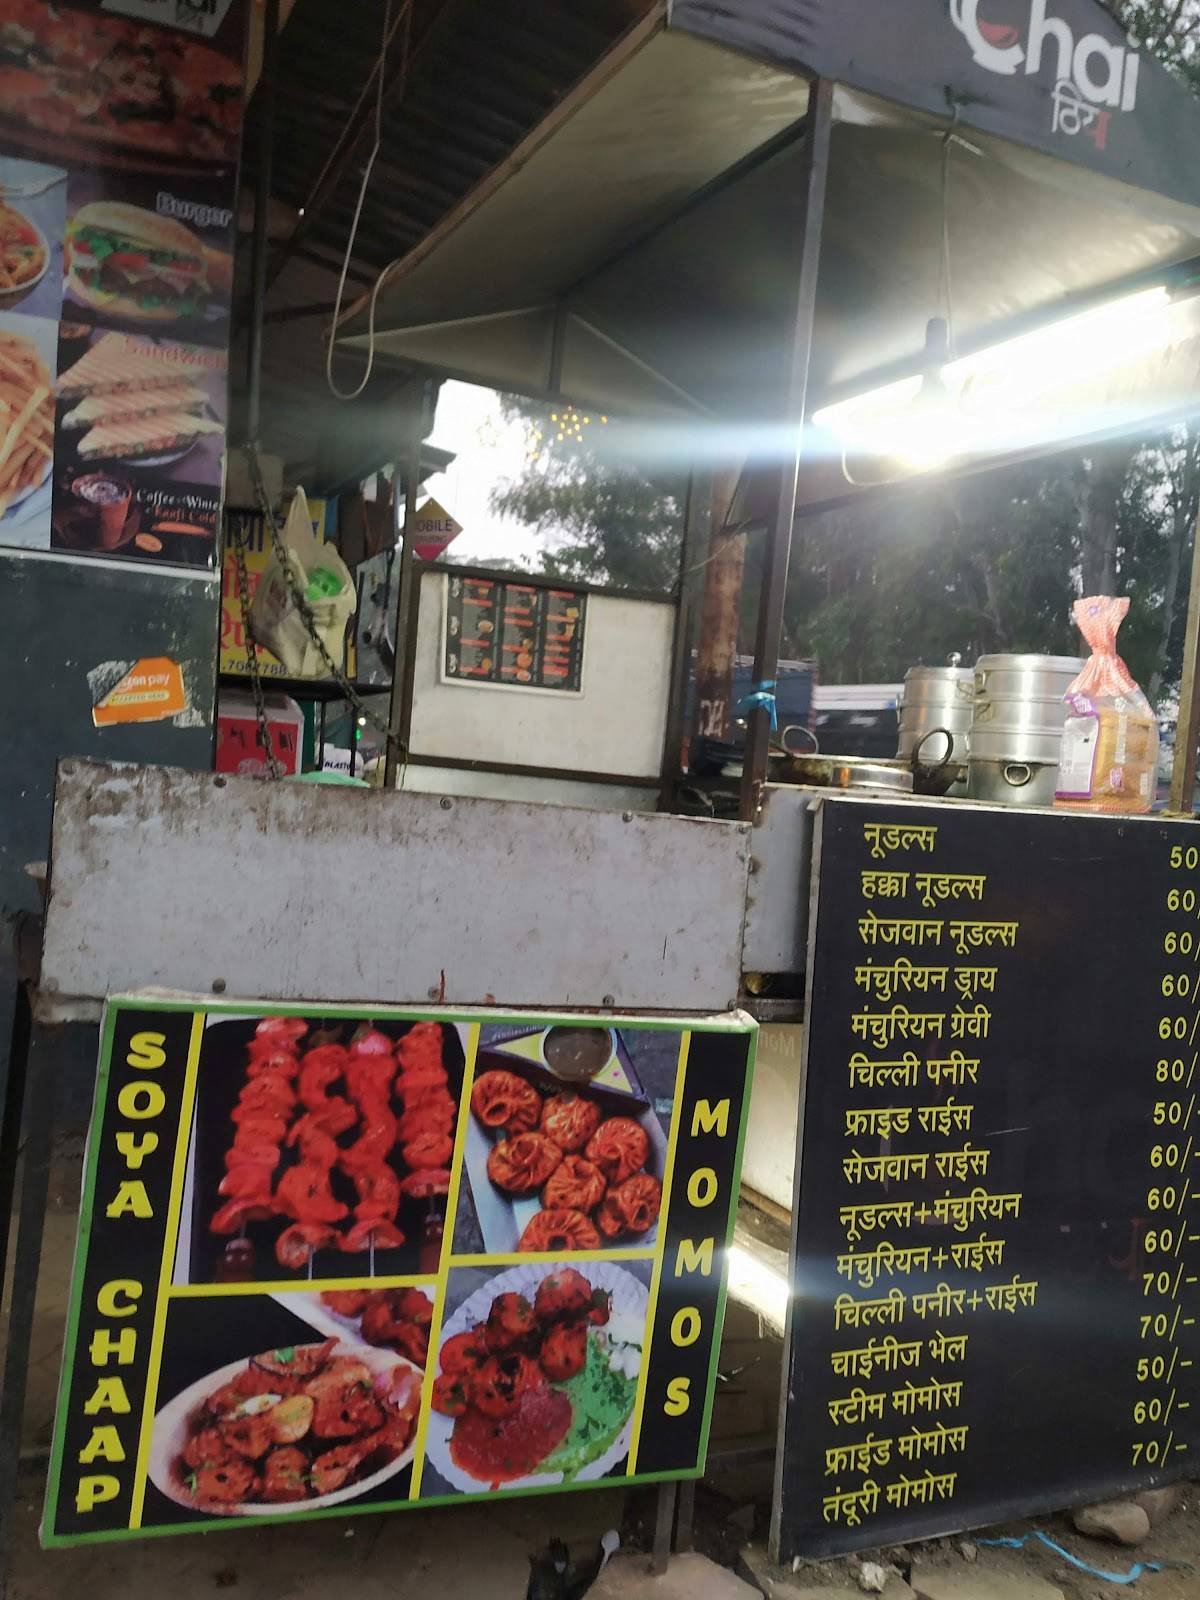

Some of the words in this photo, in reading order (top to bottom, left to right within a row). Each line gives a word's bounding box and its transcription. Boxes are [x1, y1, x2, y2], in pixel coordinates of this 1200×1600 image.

[950, 0, 1140, 112] Chai
[414, 518, 453, 532] OBILE
[864, 823, 938, 857] नूडल्स
[915, 873, 987, 907] नूडल्स
[858, 910, 944, 945] सेजवान
[949, 920, 1019, 955] नूडल्स
[855, 956, 949, 1002] मंचुरियन
[955, 967, 998, 998] ड्राय
[851, 1004, 946, 1049] मंचुरियन
[848, 1051, 922, 1088] चिल्ली
[926, 1050, 981, 1086] पनीर
[105, 1032, 168, 1220] SOYA
[918, 1096, 974, 1136] राईस
[843, 1151, 929, 1183] सेजवान
[935, 1142, 989, 1181] राईस
[1147, 1177, 1200, 1216] 60/-
[663, 1098, 731, 1417] MOMOS
[1144, 1219, 1200, 1258] 60/-
[834, 1283, 905, 1329] चिल्ली
[1142, 1261, 1198, 1300] 70/-
[831, 1335, 922, 1378] चाईनीज
[928, 1331, 968, 1361] भेल
[1139, 1303, 1195, 1343] 70/-
[74, 1278, 144, 1513] CHAAP
[829, 1387, 887, 1425] स्टीम
[892, 1377, 962, 1412] मोमोस
[1136, 1346, 1193, 1385] 50/-
[898, 1423, 969, 1460] मोमोस
[1133, 1388, 1190, 1427] 60/-
[823, 1479, 881, 1526] तंदूरी
[886, 1469, 957, 1506] मोमोस
[1131, 1430, 1188, 1469] 70/-
